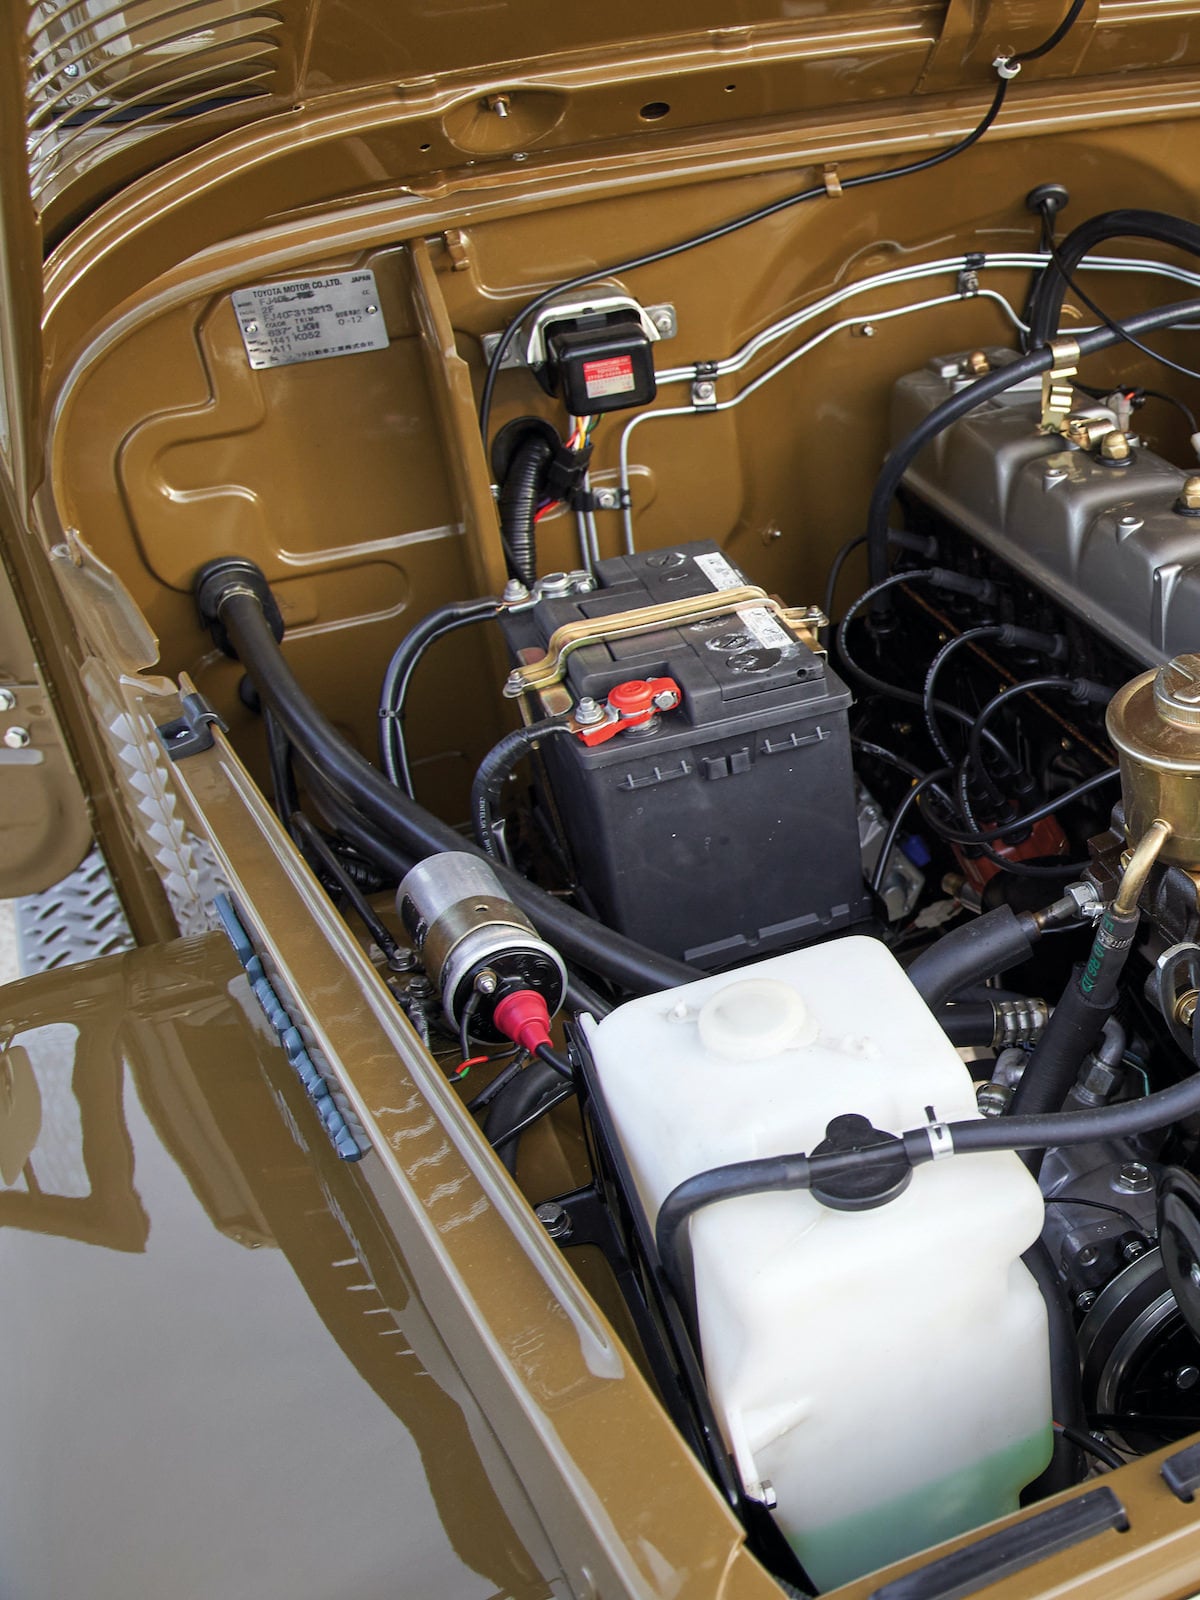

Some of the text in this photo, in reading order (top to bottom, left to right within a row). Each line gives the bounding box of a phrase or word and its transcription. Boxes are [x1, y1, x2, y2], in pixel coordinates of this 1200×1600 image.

[253, 286, 282, 298] TOYOTA
[283, 282, 310, 294] MOTOR
[351, 274, 371, 283] JAPAN
[295, 316, 314, 324] TRIM
